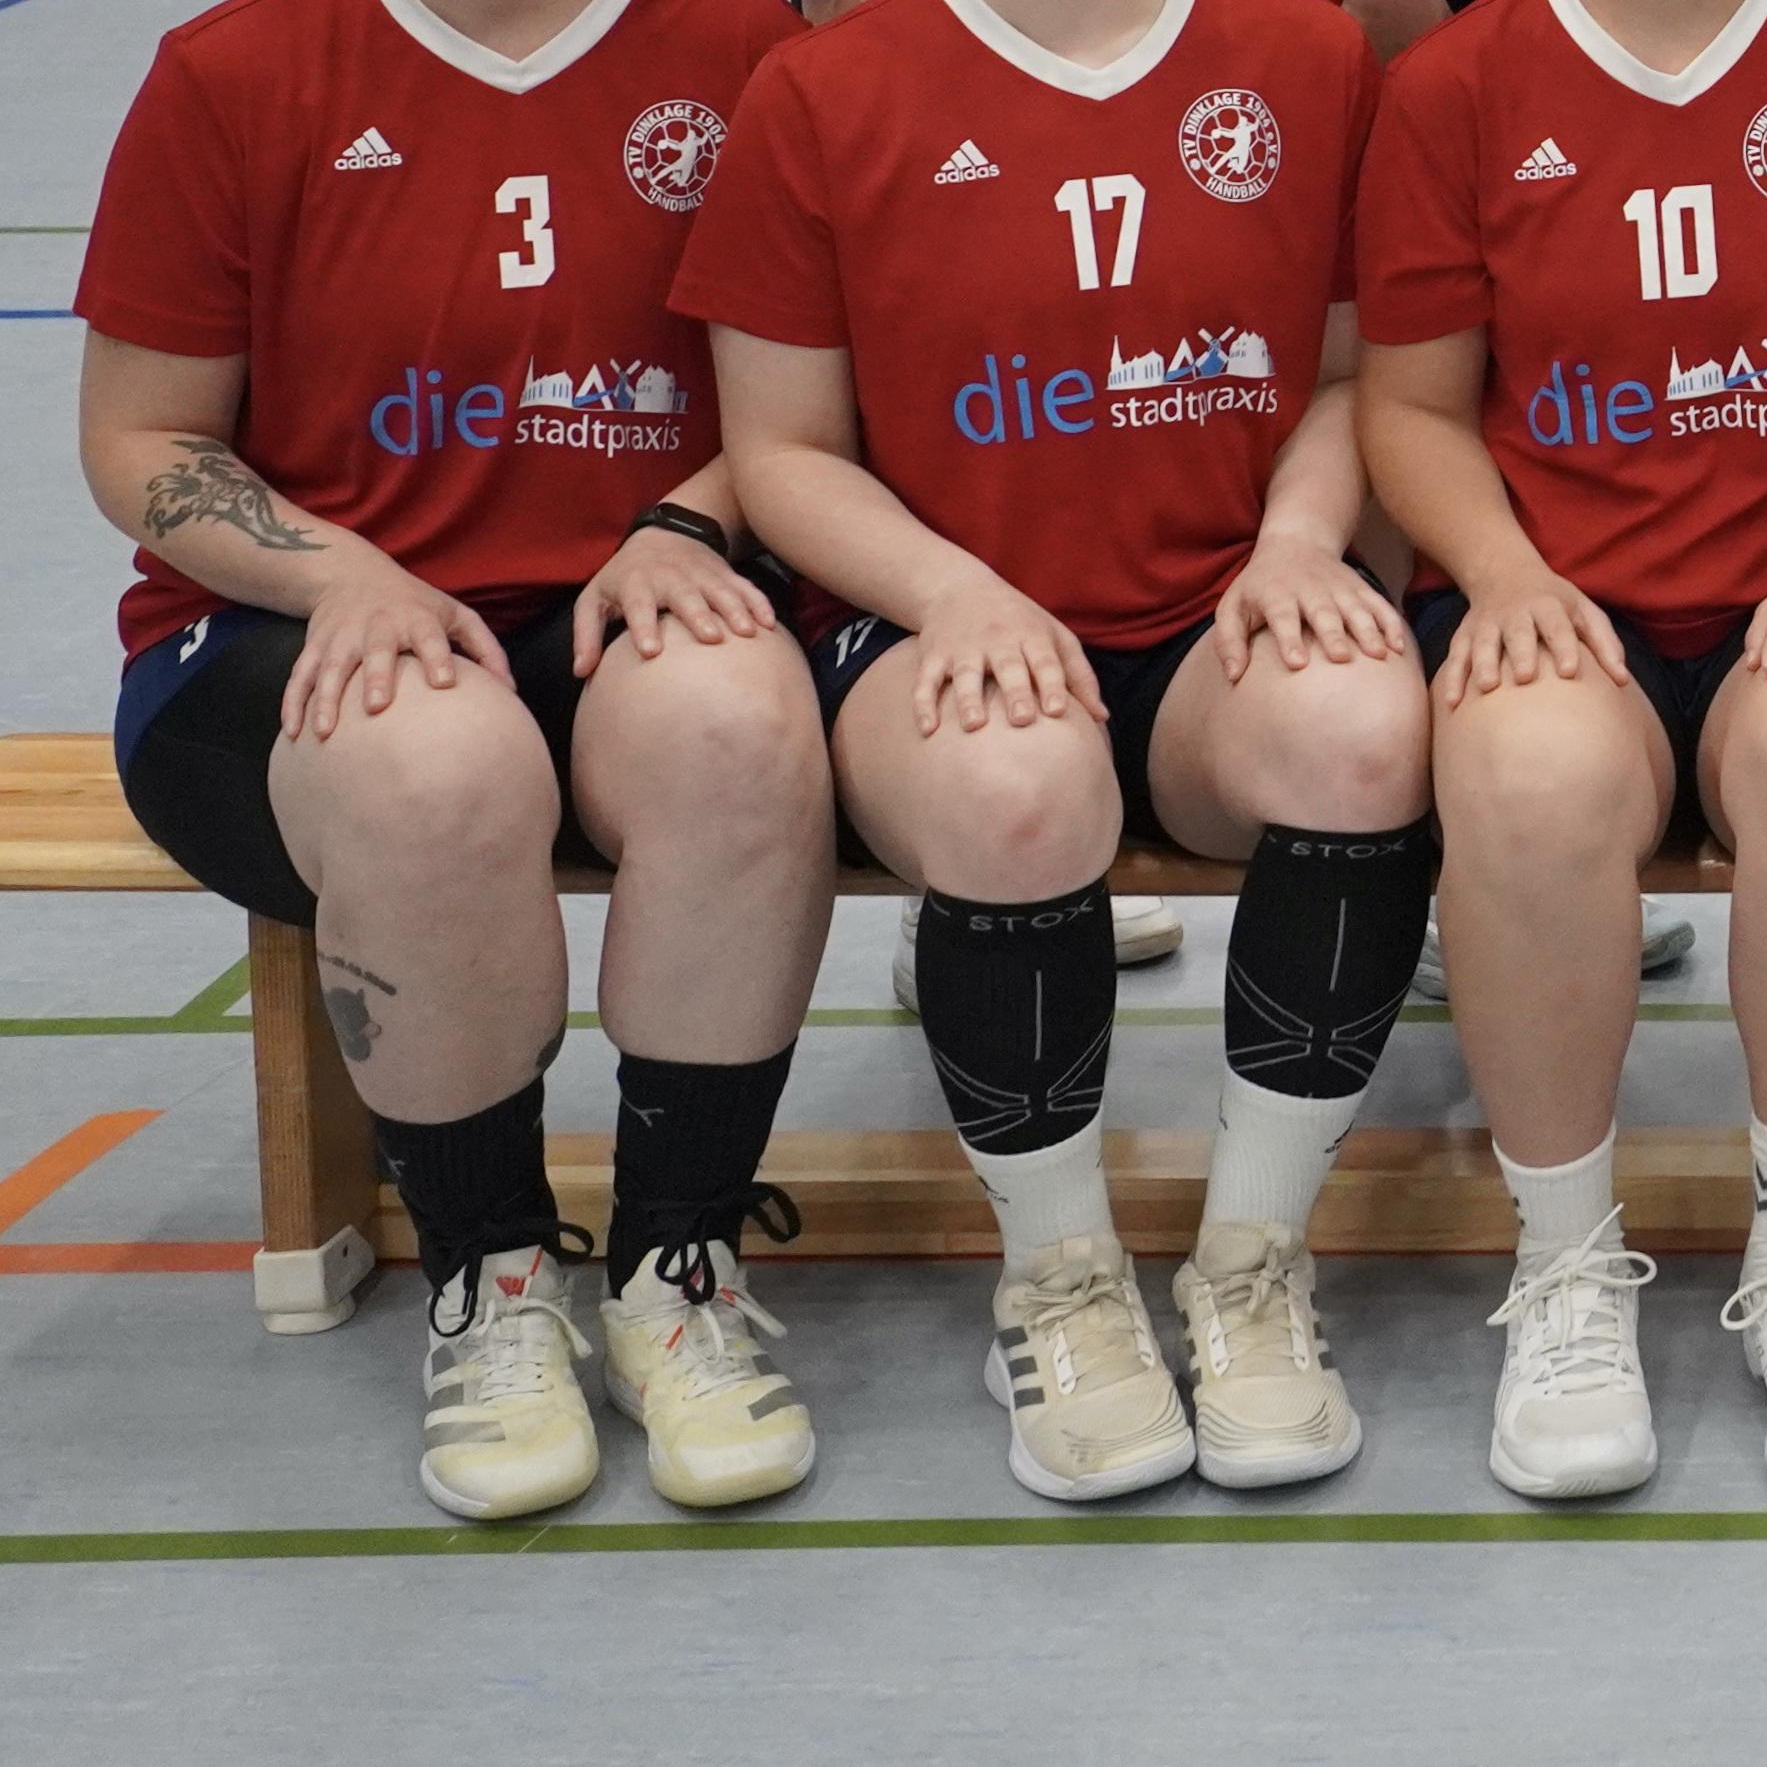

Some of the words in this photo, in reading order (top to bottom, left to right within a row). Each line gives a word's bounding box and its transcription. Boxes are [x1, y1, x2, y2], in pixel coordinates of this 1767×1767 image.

[631, 104, 693, 143] DINKLAGE
[1184, 92, 1241, 135] DINKLAGE
[334, 153, 402, 170] adidas
[629, 146, 642, 164] TV
[1182, 138, 1196, 157] TV
[1747, 145, 1761, 164] TV
[935, 164, 1000, 184] adidas
[1206, 176, 1267, 199] HANDBALL
[1514, 163, 1576, 180] adidas
[496, 176, 554, 288] 3
[1055, 174, 1145, 290] 17
[1624, 185, 1717, 300] 10
[370, 368, 504, 454] die
[515, 414, 680, 458] stadtpraxis
[954, 354, 1094, 444] die
[1106, 383, 1278, 428] stadtpraxis
[1530, 363, 1653, 445] die
[836, 616, 880, 669] 17
[1290, 838, 1406, 859] STOX
[969, 896, 1094, 933] STOX
